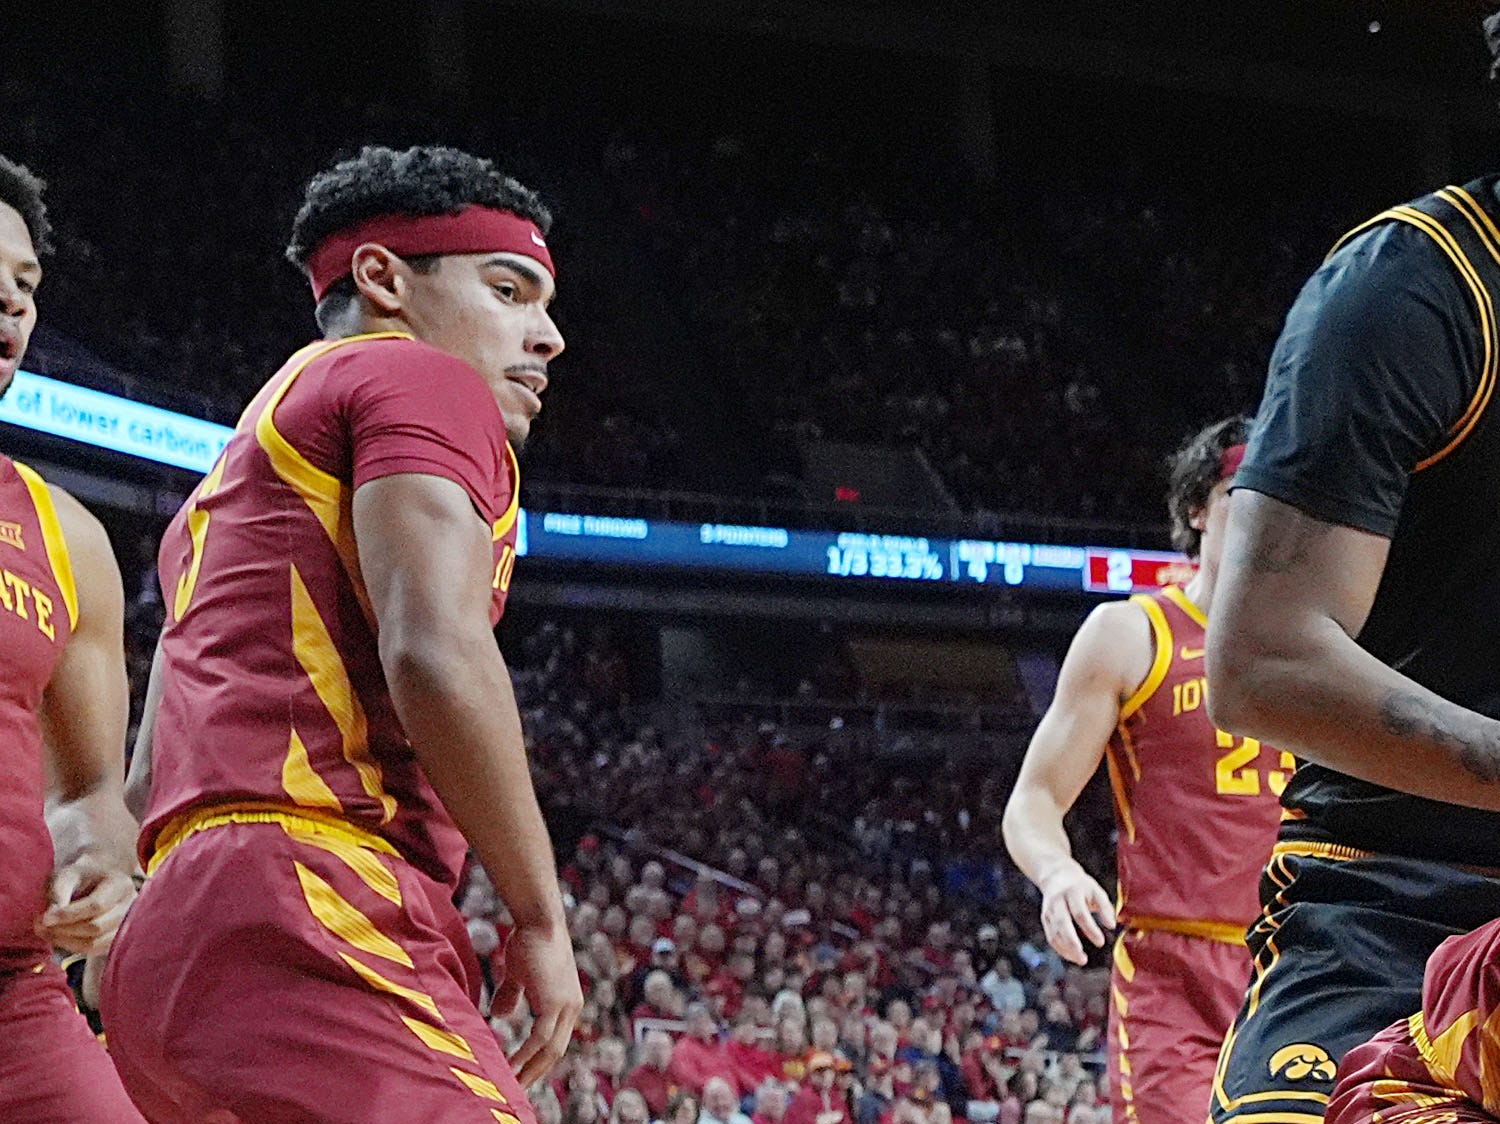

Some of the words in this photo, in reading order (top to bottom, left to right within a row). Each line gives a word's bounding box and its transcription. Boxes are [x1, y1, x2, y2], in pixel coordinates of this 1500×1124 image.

[51, 396, 118, 429] lower
[128, 422, 210, 456] carbon
[1107, 552, 1133, 591] 2
[1172, 676, 1208, 716] IO
